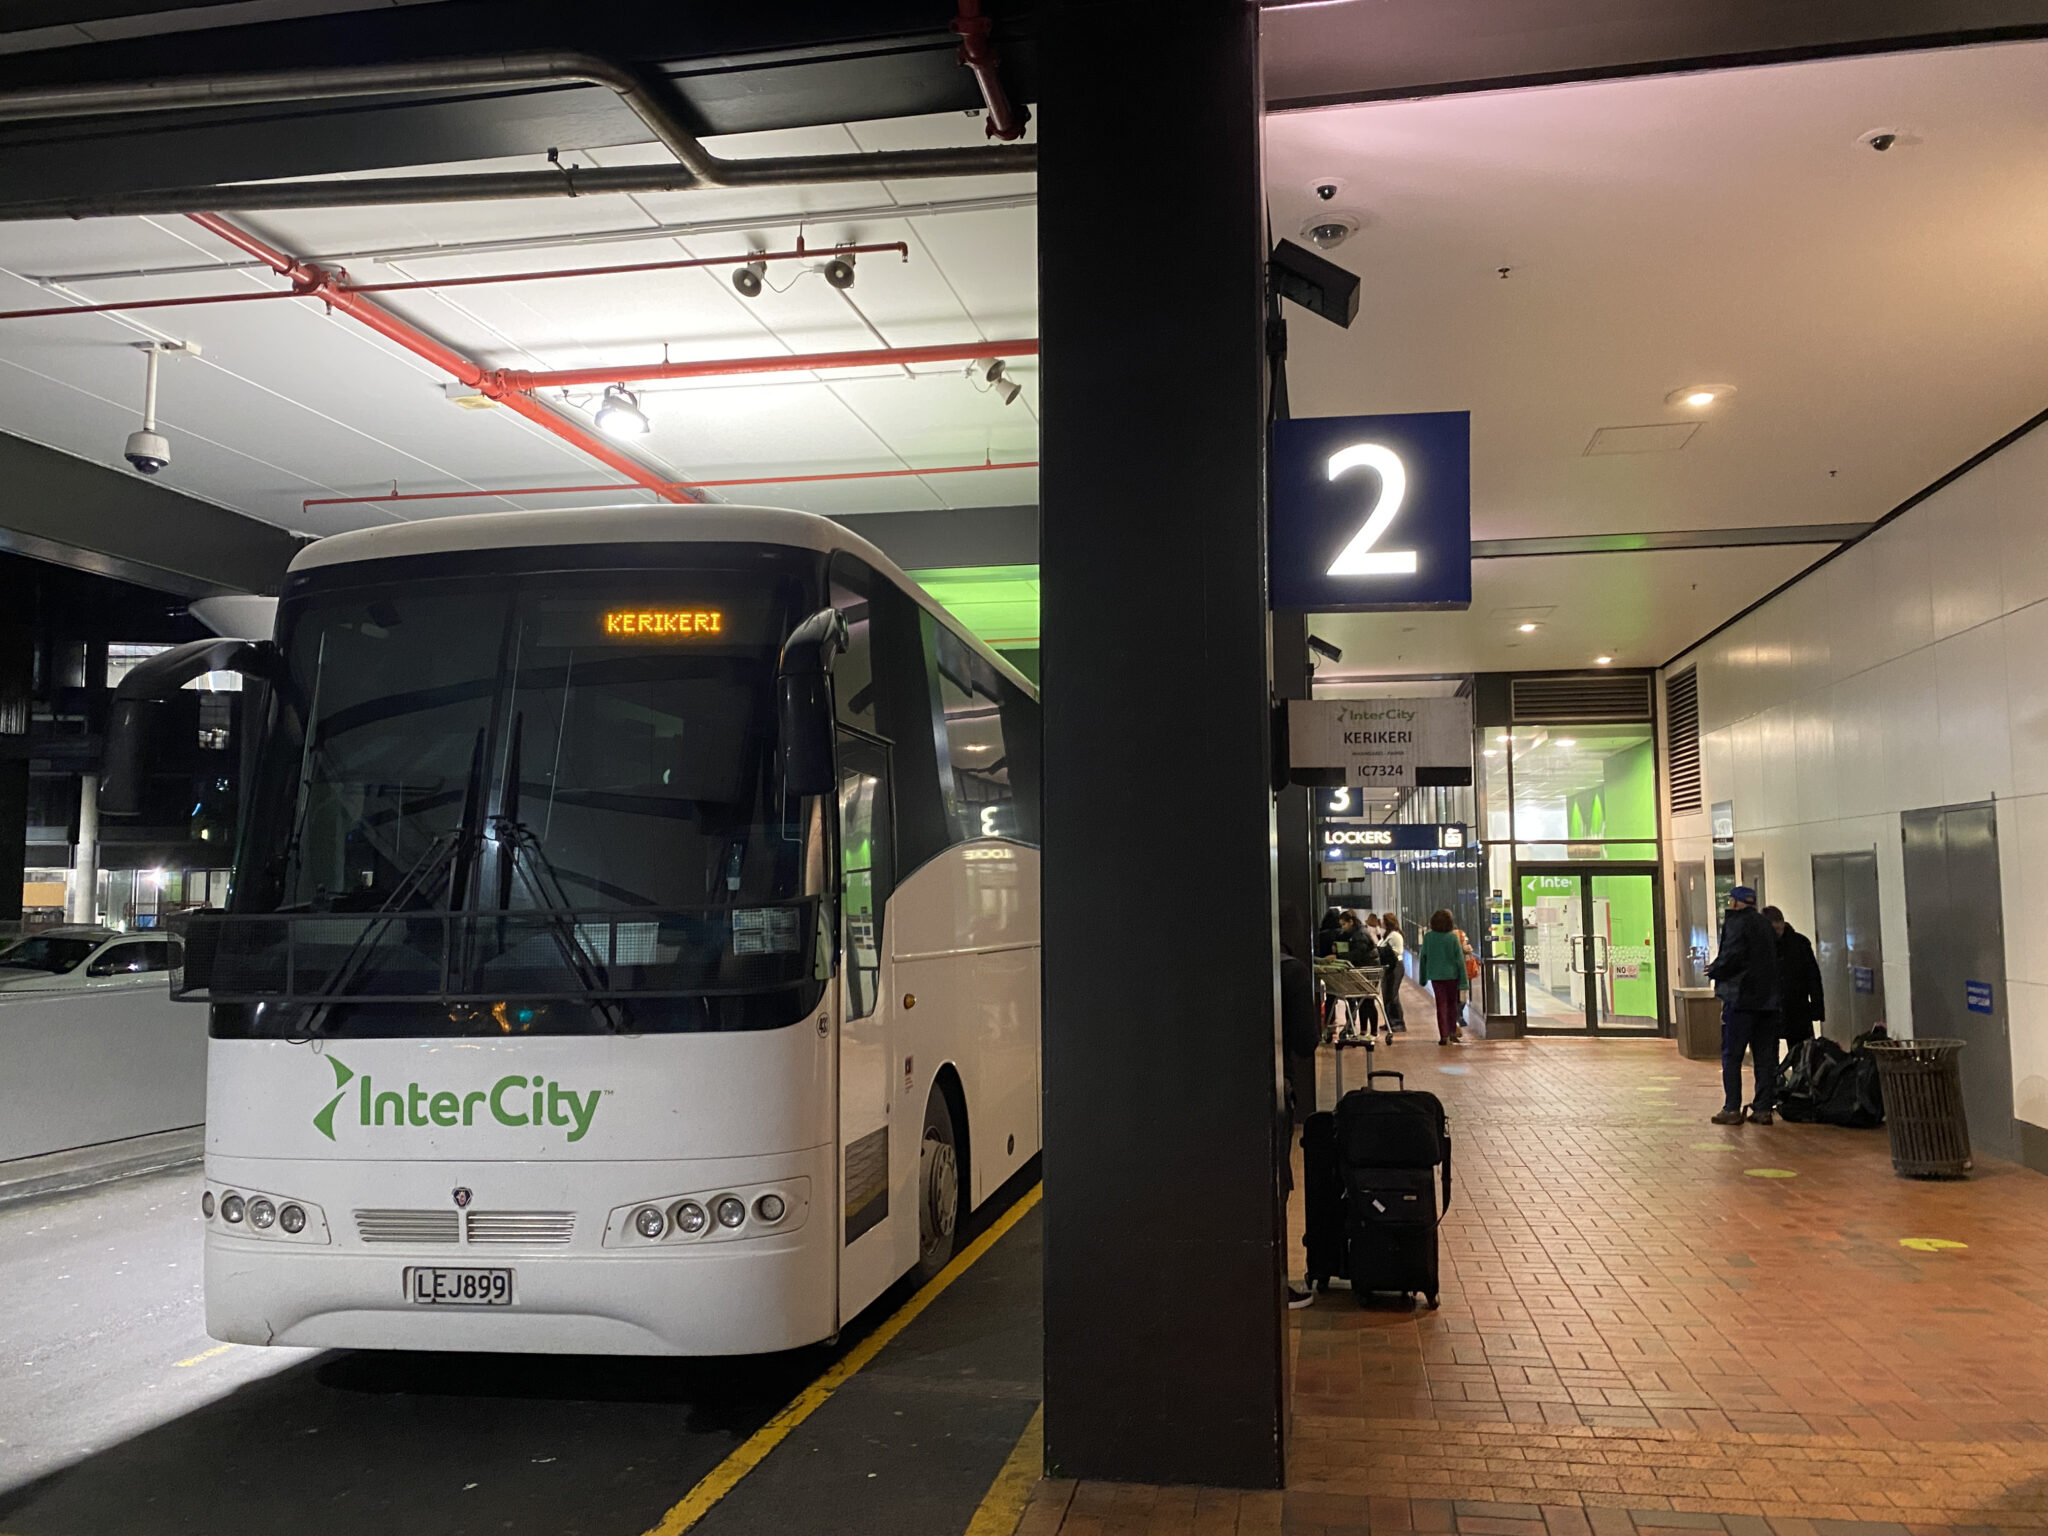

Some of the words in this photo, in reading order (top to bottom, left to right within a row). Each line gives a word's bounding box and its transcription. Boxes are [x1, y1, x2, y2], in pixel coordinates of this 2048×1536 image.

[1326, 443, 1416, 576] 2
[607, 614, 721, 632] KERIKERI
[1351, 709, 1416, 722] InterCity
[1344, 731, 1412, 744] KERIKERI
[1358, 765, 1403, 776] IC7324
[1330, 787, 1350, 811] 3
[1325, 831, 1392, 844] LOCKERS
[1540, 876, 1572, 888] Inte
[360, 1075, 602, 1142] InterCity
[418, 1275, 505, 1298] LEJ899
